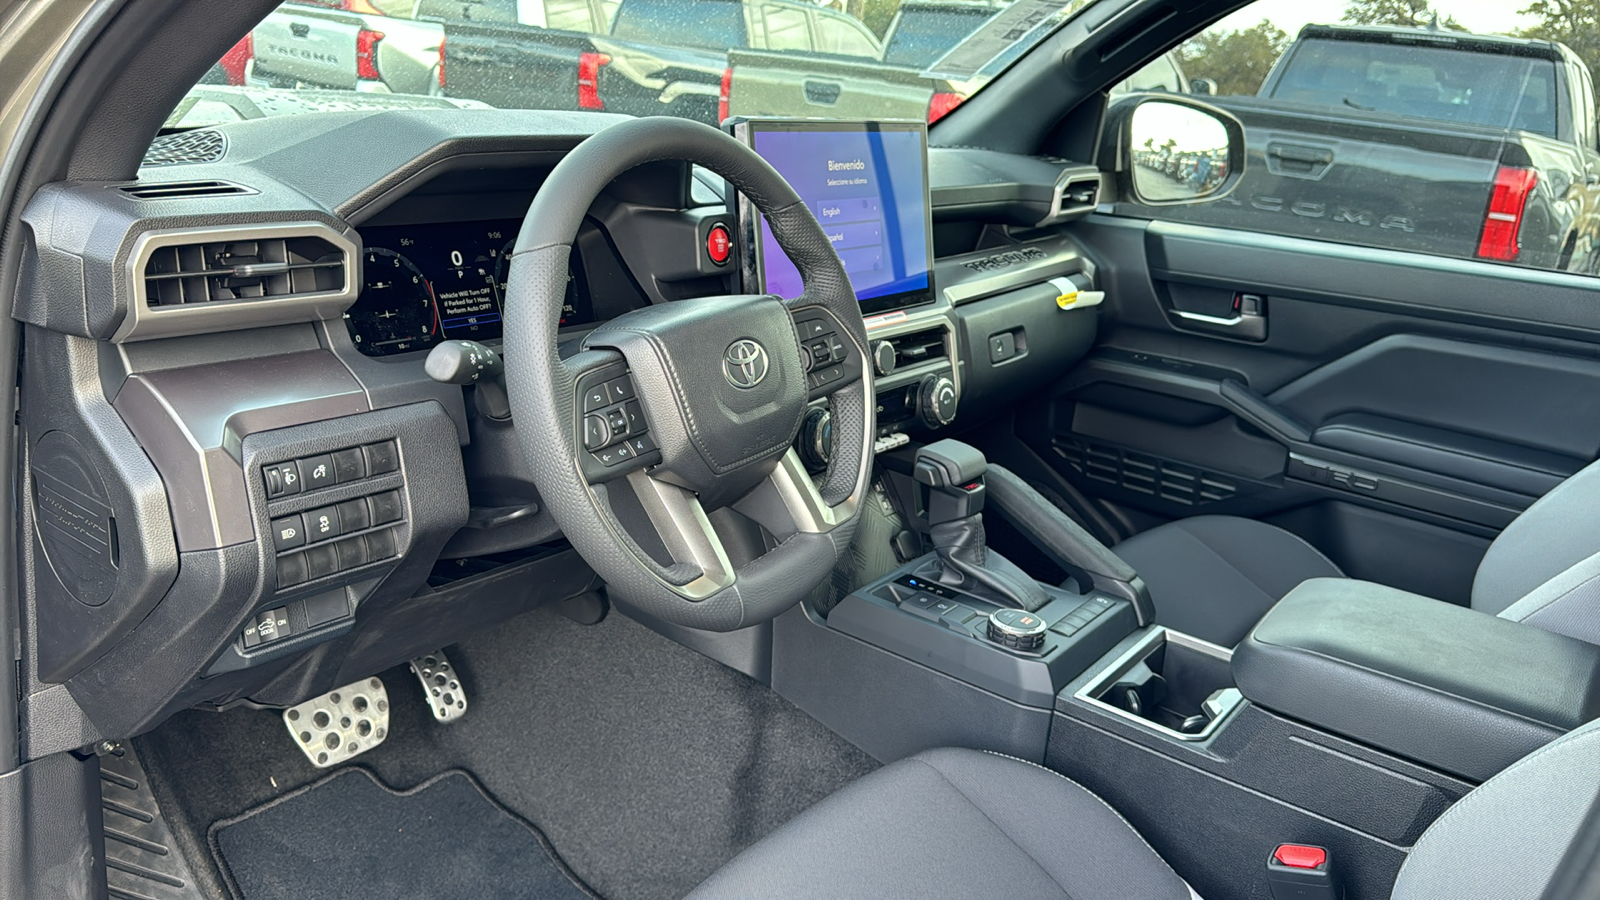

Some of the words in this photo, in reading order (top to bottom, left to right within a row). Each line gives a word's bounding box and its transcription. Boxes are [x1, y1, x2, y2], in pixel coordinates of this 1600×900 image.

[267, 44, 339, 66] TACOMA
[828, 159, 865, 171] Bienvenido
[823, 208, 840, 217] English
[487, 231, 502, 239] 9:06
[393, 258, 400, 268] 5
[450, 250, 464, 267] 0
[457, 270, 464, 279] P
[412, 275, 419, 284] 6
[422, 299, 428, 308] 7
[421, 325, 428, 334] 8
[320, 525, 330, 533] OFF
[277, 618, 287, 626] ON
[245, 627, 256, 636] OFF
